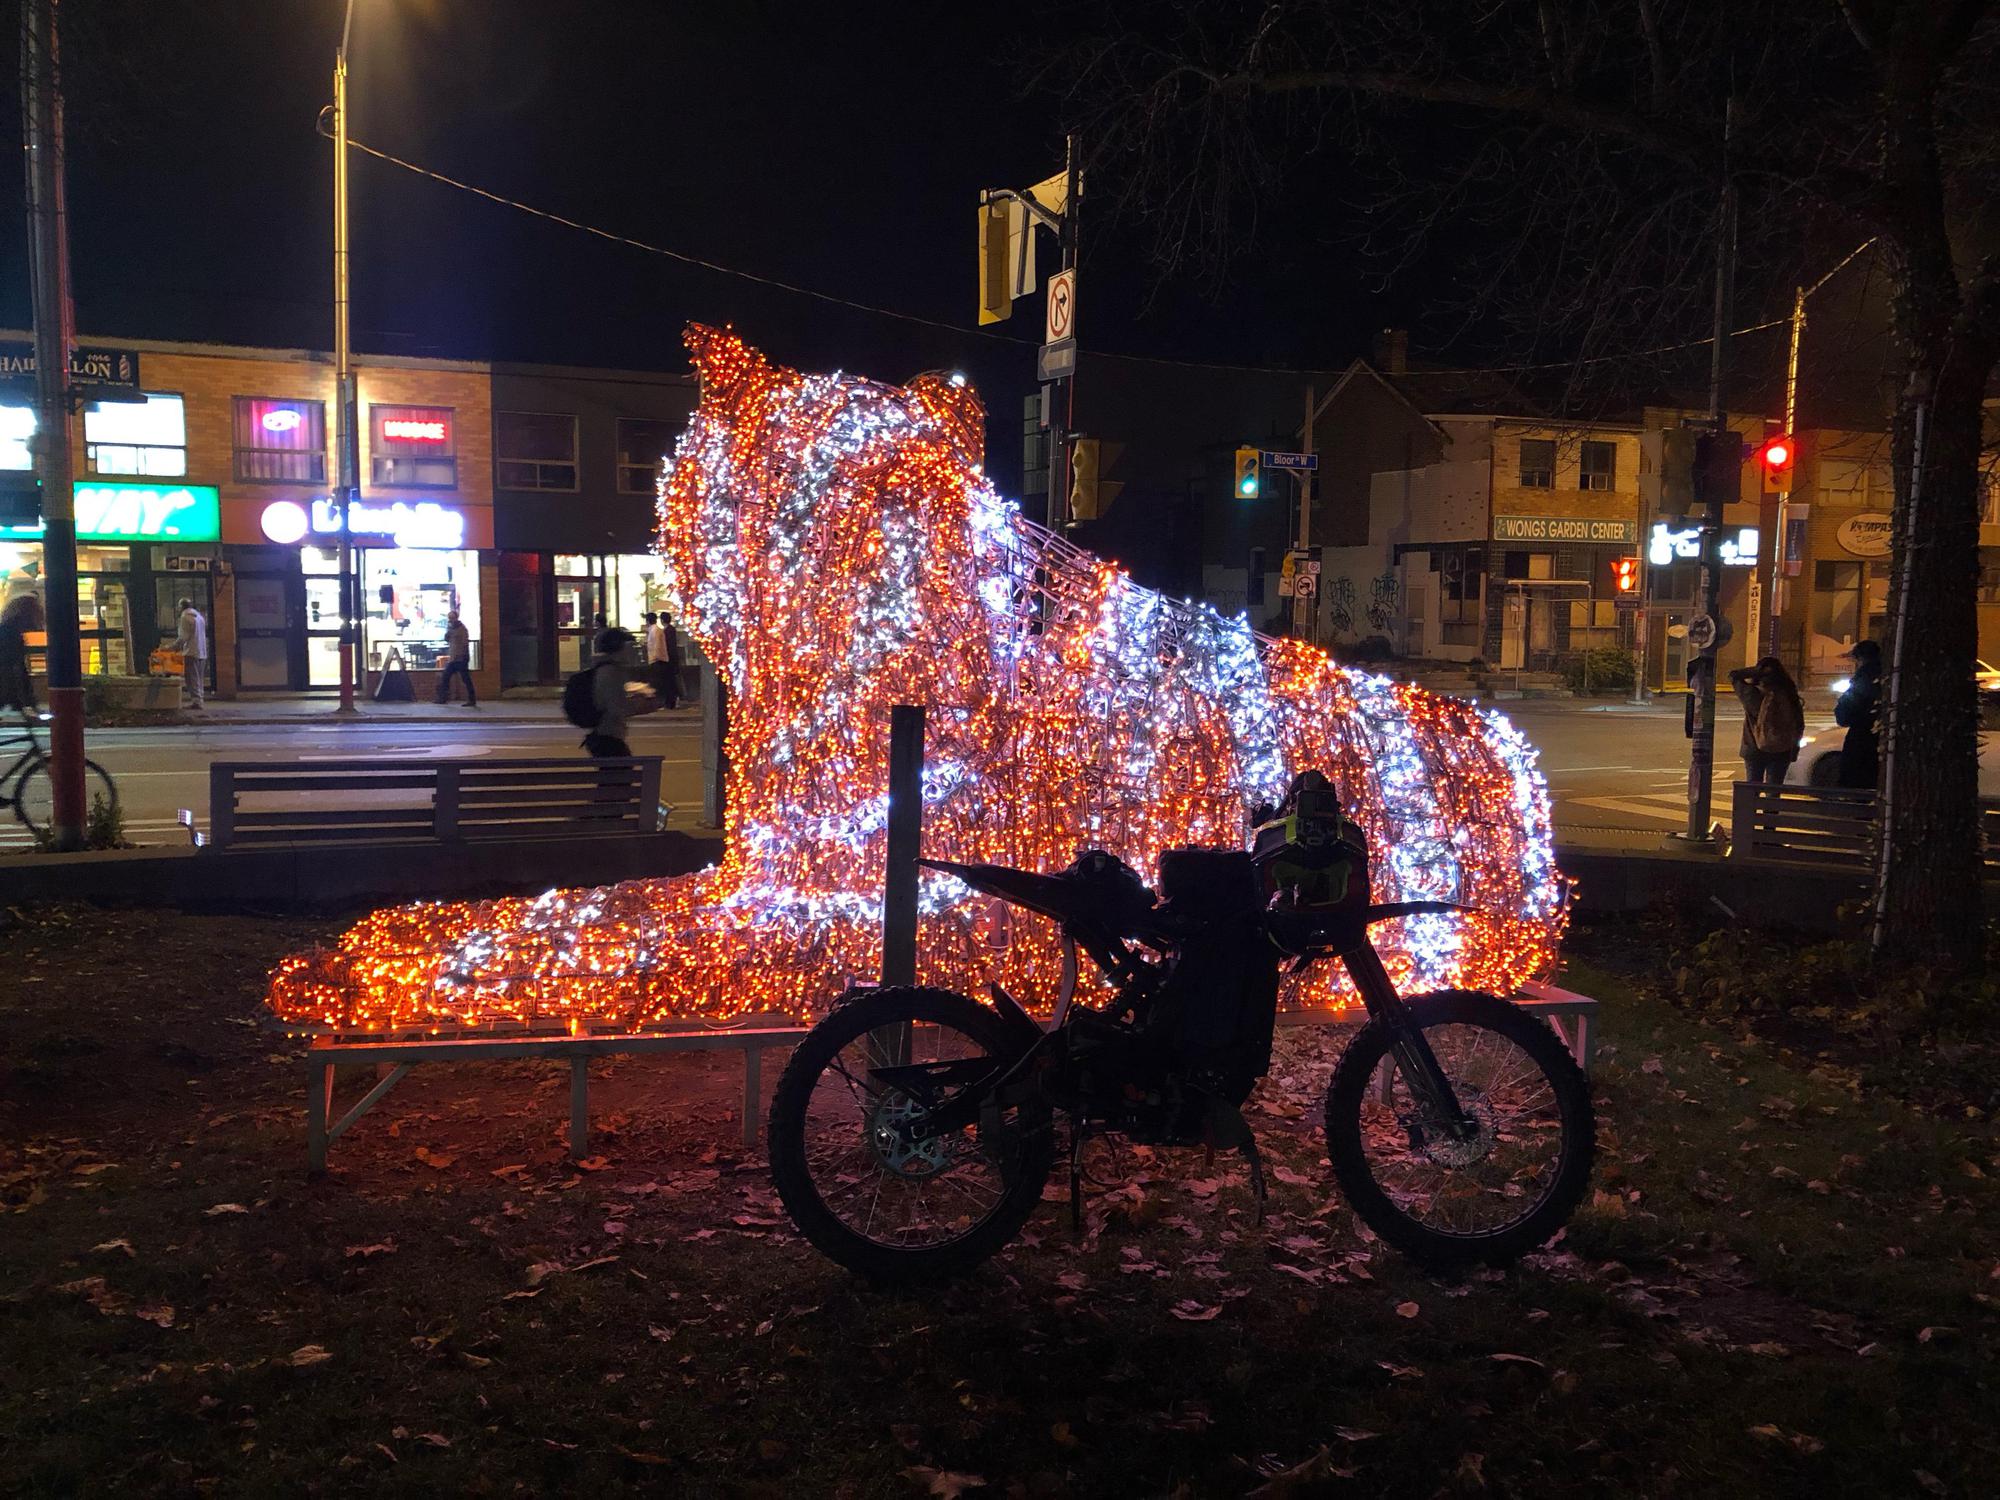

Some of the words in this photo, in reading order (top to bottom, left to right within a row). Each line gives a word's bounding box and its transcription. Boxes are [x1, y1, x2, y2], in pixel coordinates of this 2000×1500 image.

[0, 357, 37, 372] HAI
[70, 361, 111, 378] LON
[1274, 455, 1295, 465] Bloor
[1300, 456, 1308, 466] W
[74, 488, 196, 534] WAY
[1506, 520, 1546, 537] WONGS
[1548, 521, 1588, 539] GARDEN
[1591, 522, 1625, 540] CENTER
